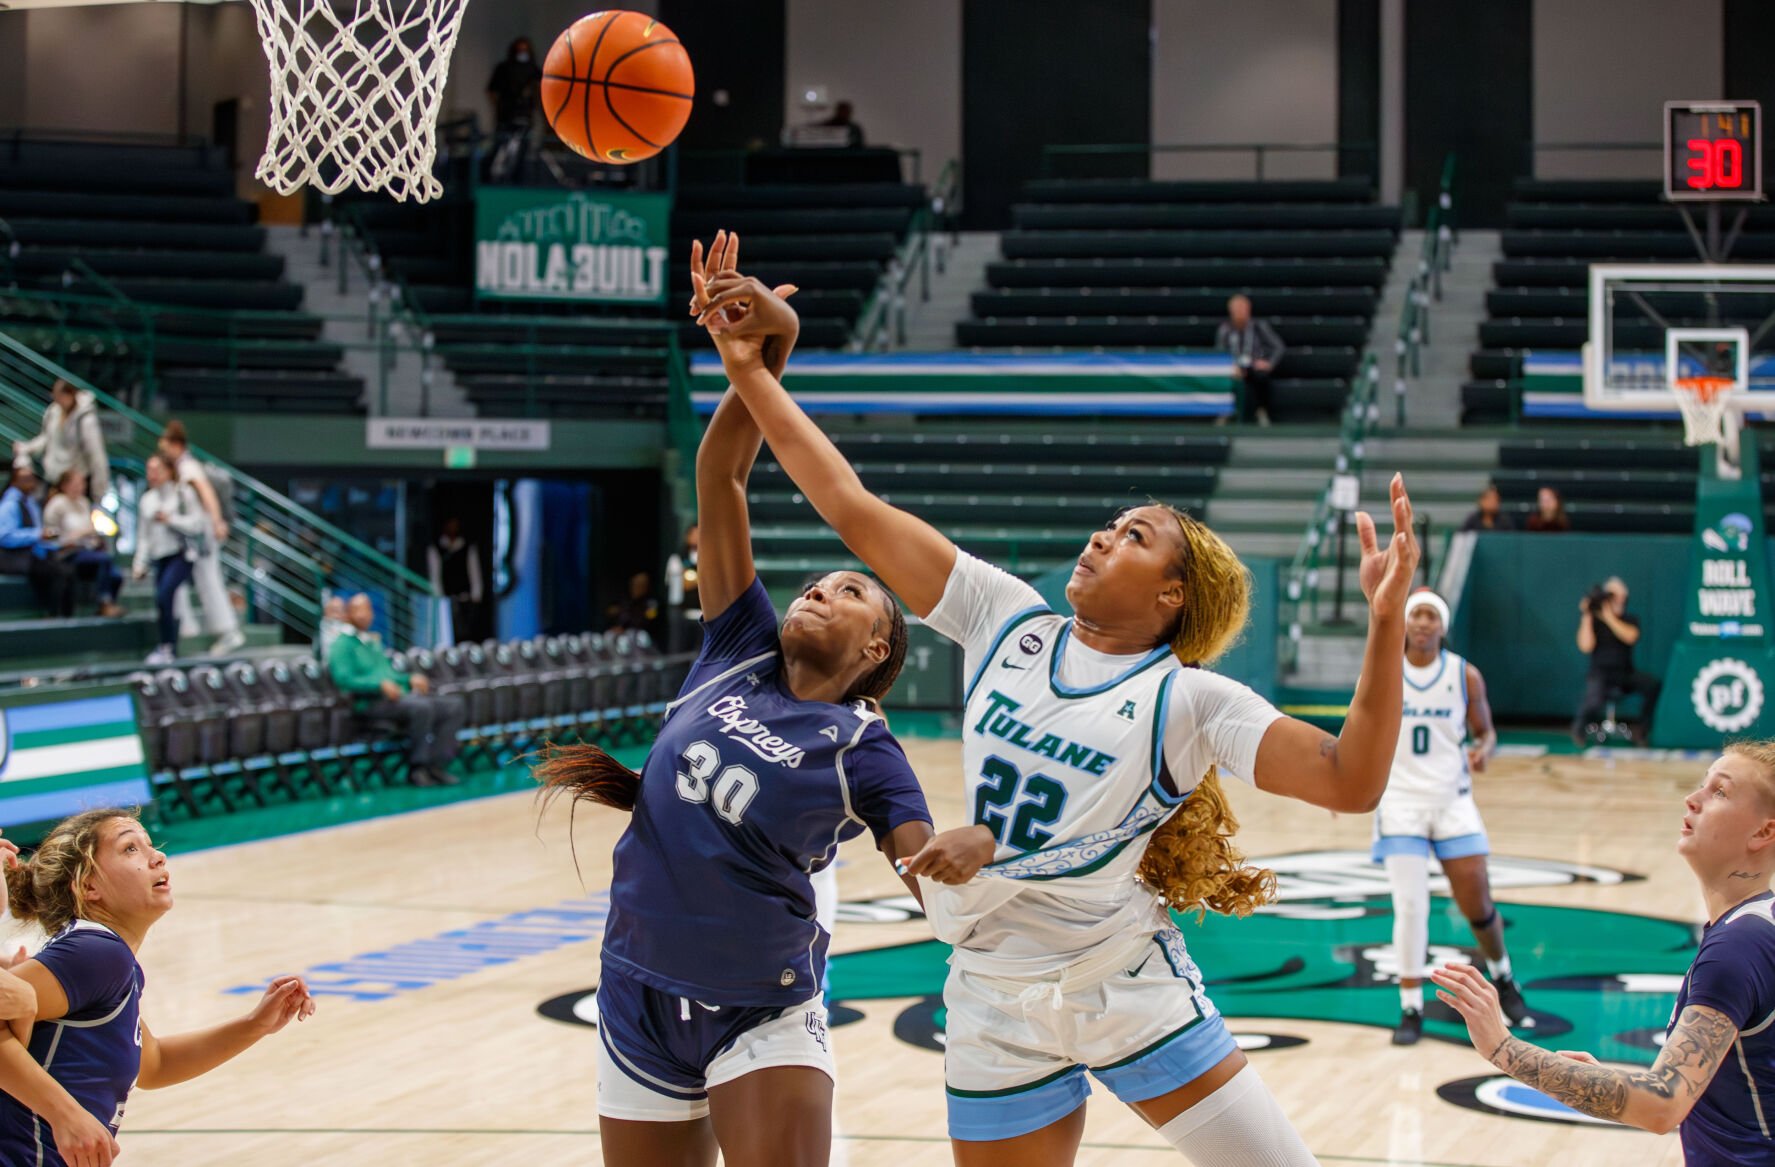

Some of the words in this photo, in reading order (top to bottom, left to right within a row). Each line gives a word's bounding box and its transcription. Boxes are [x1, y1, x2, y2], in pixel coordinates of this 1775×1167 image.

[1687, 139, 1742, 188] 30
[1702, 559, 1752, 588] ROLL
[1698, 587, 1756, 617] WAVE
[1711, 679, 1743, 714] pf
[707, 695, 806, 769] Ospreys
[974, 689, 1118, 777] TULANE
[1412, 724, 1430, 755] 0
[675, 739, 761, 827] 30
[974, 753, 1069, 852] 22
